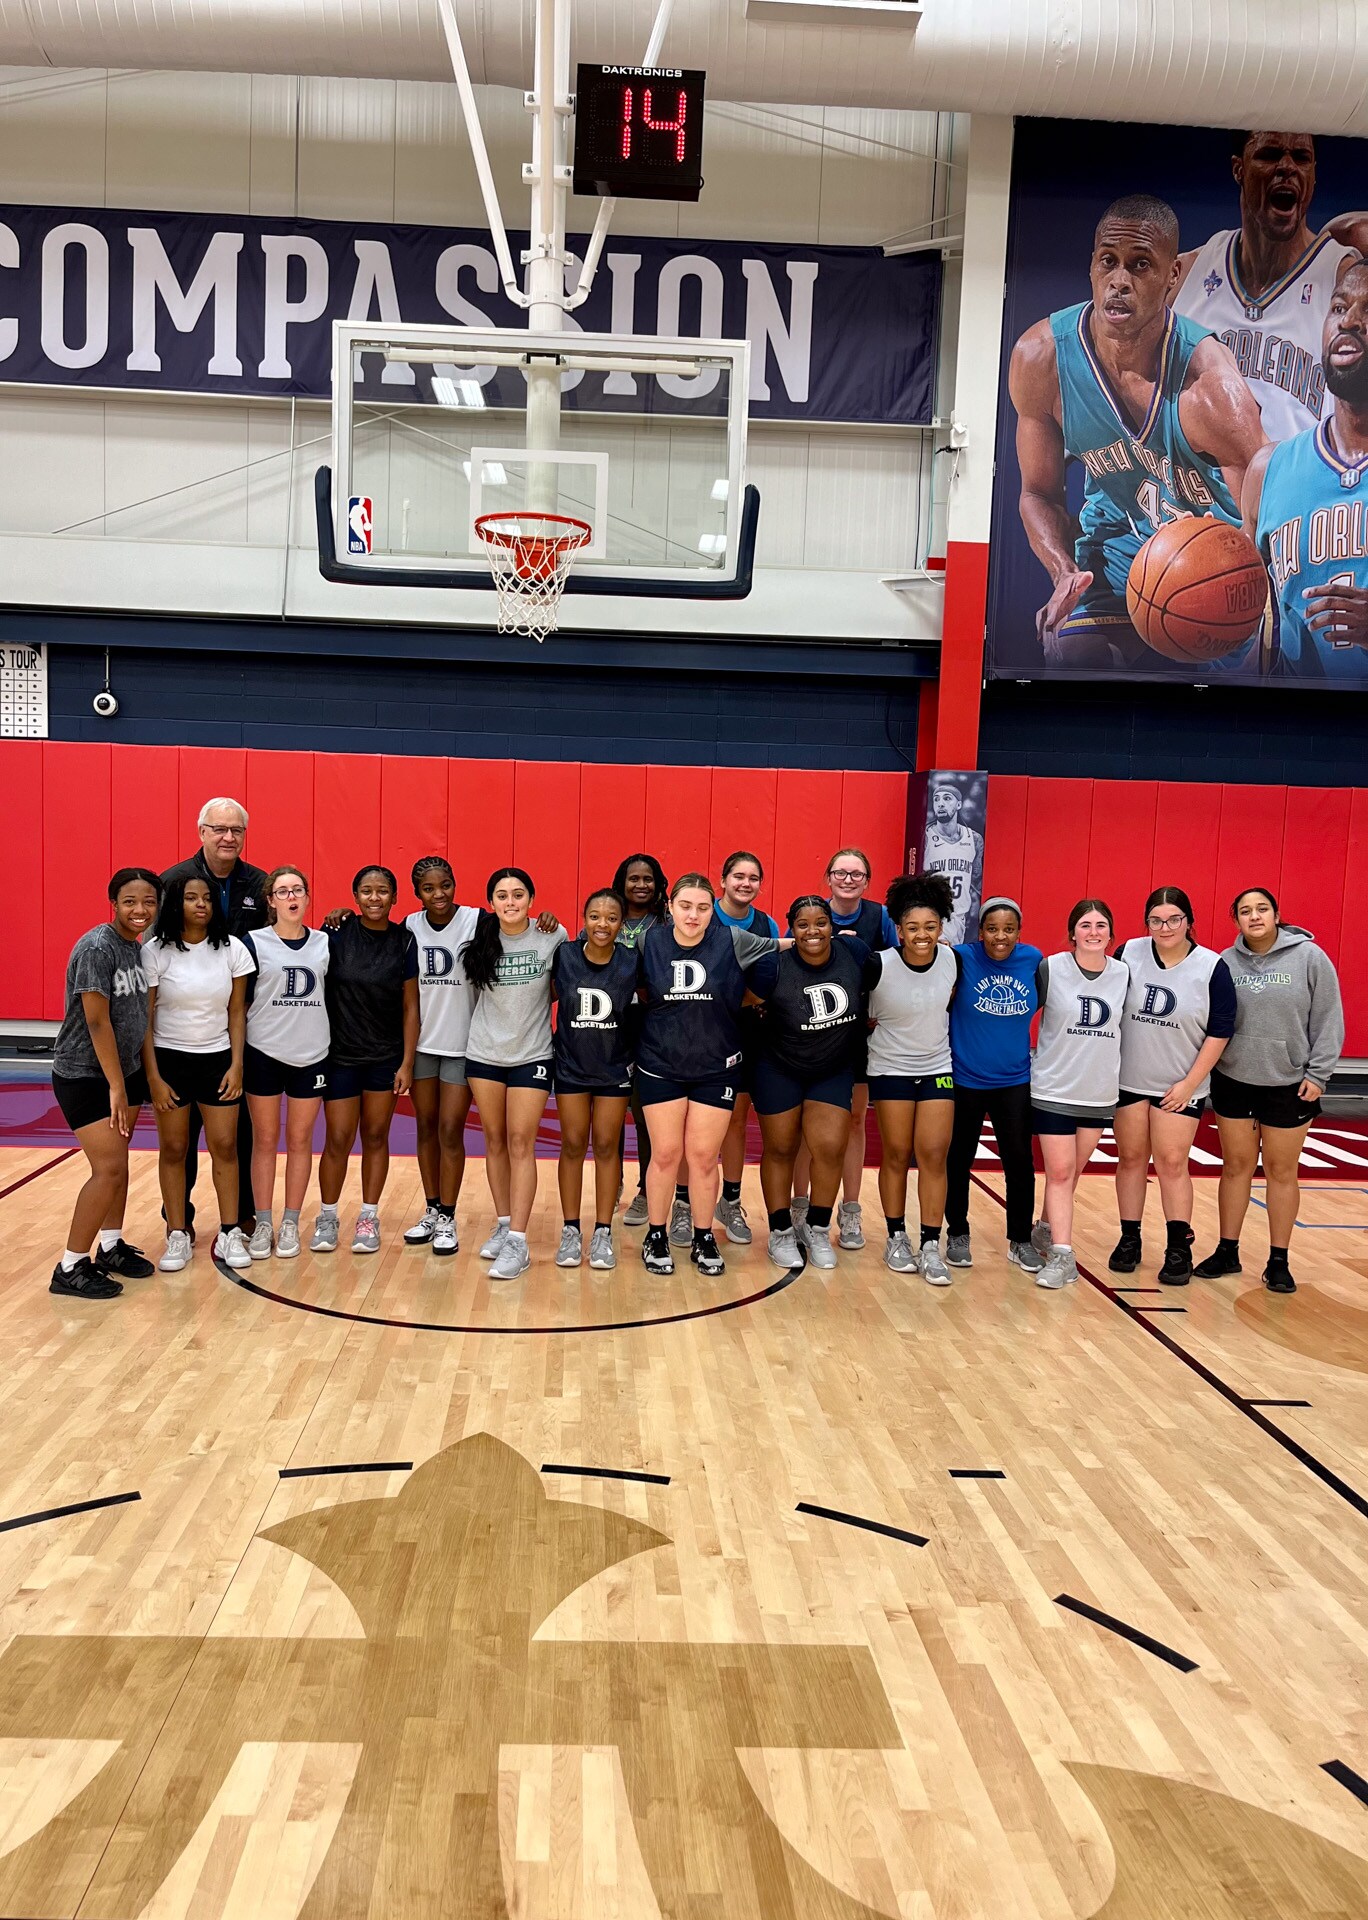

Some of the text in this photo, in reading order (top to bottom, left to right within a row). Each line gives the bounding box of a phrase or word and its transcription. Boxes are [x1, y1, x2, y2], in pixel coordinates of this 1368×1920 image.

[602, 66, 682, 77] DAKTRONICS
[622, 87, 687, 162] 14
[0, 222, 819, 403] OMPASION
[1081, 439, 1134, 479] NEW
[351, 541, 363, 551] NBA
[1309, 501, 1368, 566] ORL
[10, 650, 37, 669] TOUR
[422, 946, 455, 978] D
[670, 960, 707, 993] D
[281, 966, 317, 999] D
[664, 993, 713, 1001] BASKETBALL
[974, 975, 1030, 997] LADY SWAMP OWLS
[577, 987, 612, 1021] D
[804, 983, 848, 1023] D
[985, 1000, 1021, 1014] BASKETBALL
[1075, 995, 1112, 1028] D
[1138, 983, 1177, 1018] D
[571, 1021, 618, 1029] BASKETBALL
[801, 1014, 857, 1031] BASKETBALL
[1067, 1028, 1115, 1038] BASKETBALL
[1131, 1014, 1180, 1029] BASKETBALL
